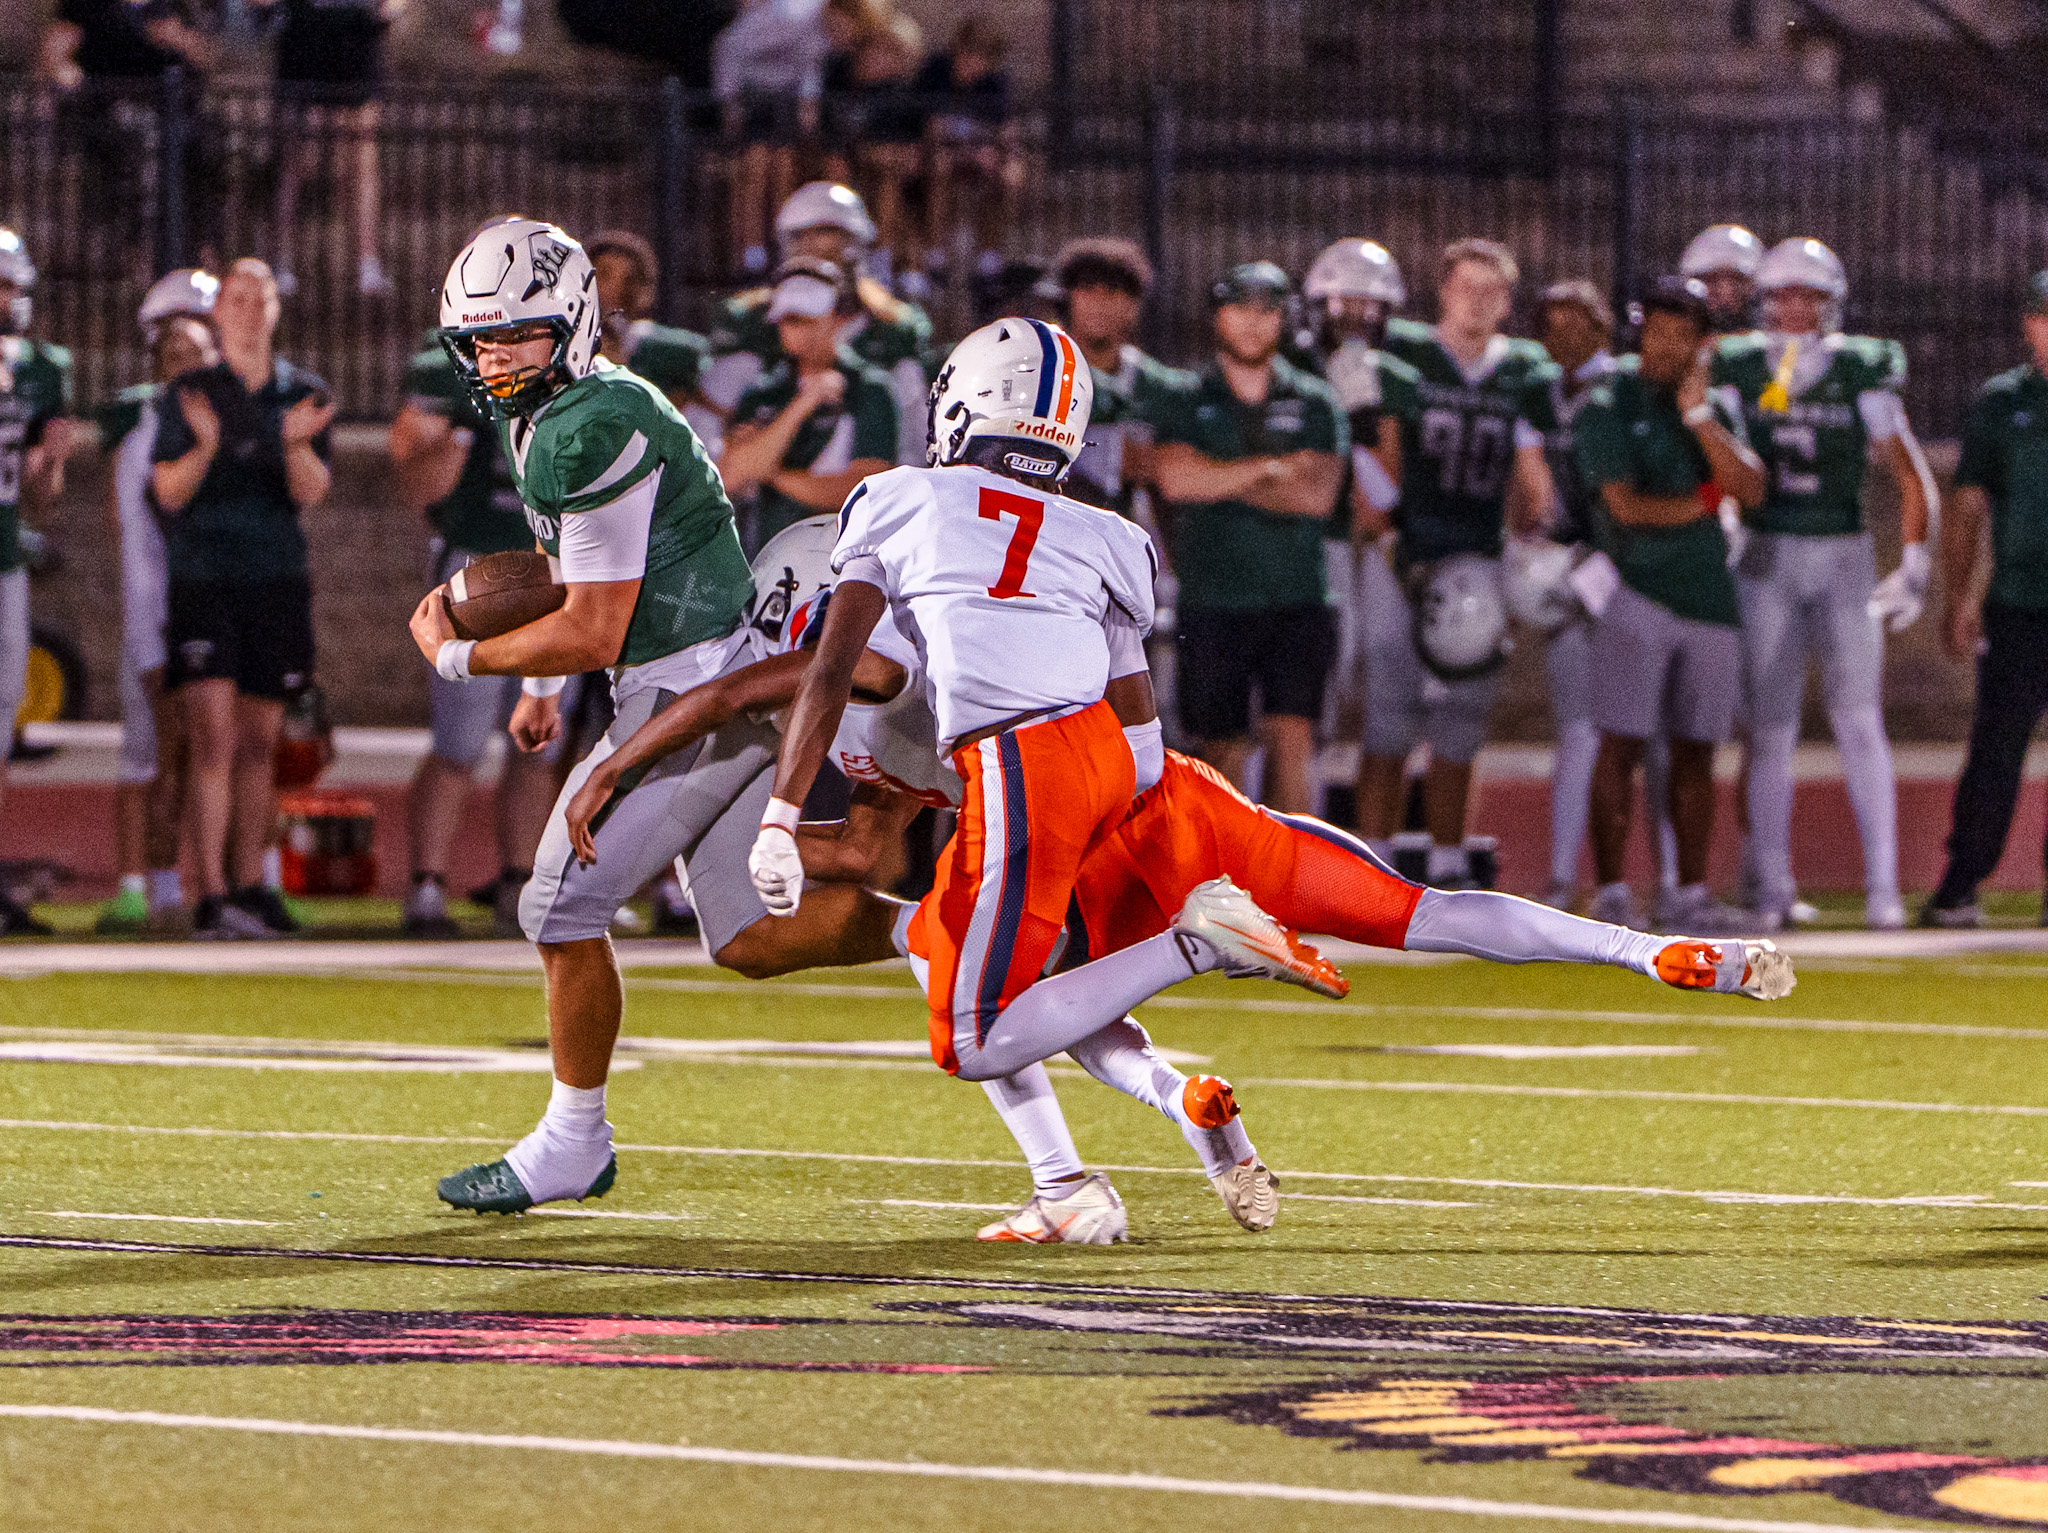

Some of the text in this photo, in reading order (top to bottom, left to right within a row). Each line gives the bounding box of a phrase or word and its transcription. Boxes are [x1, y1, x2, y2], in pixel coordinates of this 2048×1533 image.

[462, 310, 502, 323] Riddell
[1070, 398, 1079, 411] 7
[1423, 409, 1507, 497] 90
[1009, 456, 1056, 474] BATTLE
[978, 486, 1045, 600] 7
